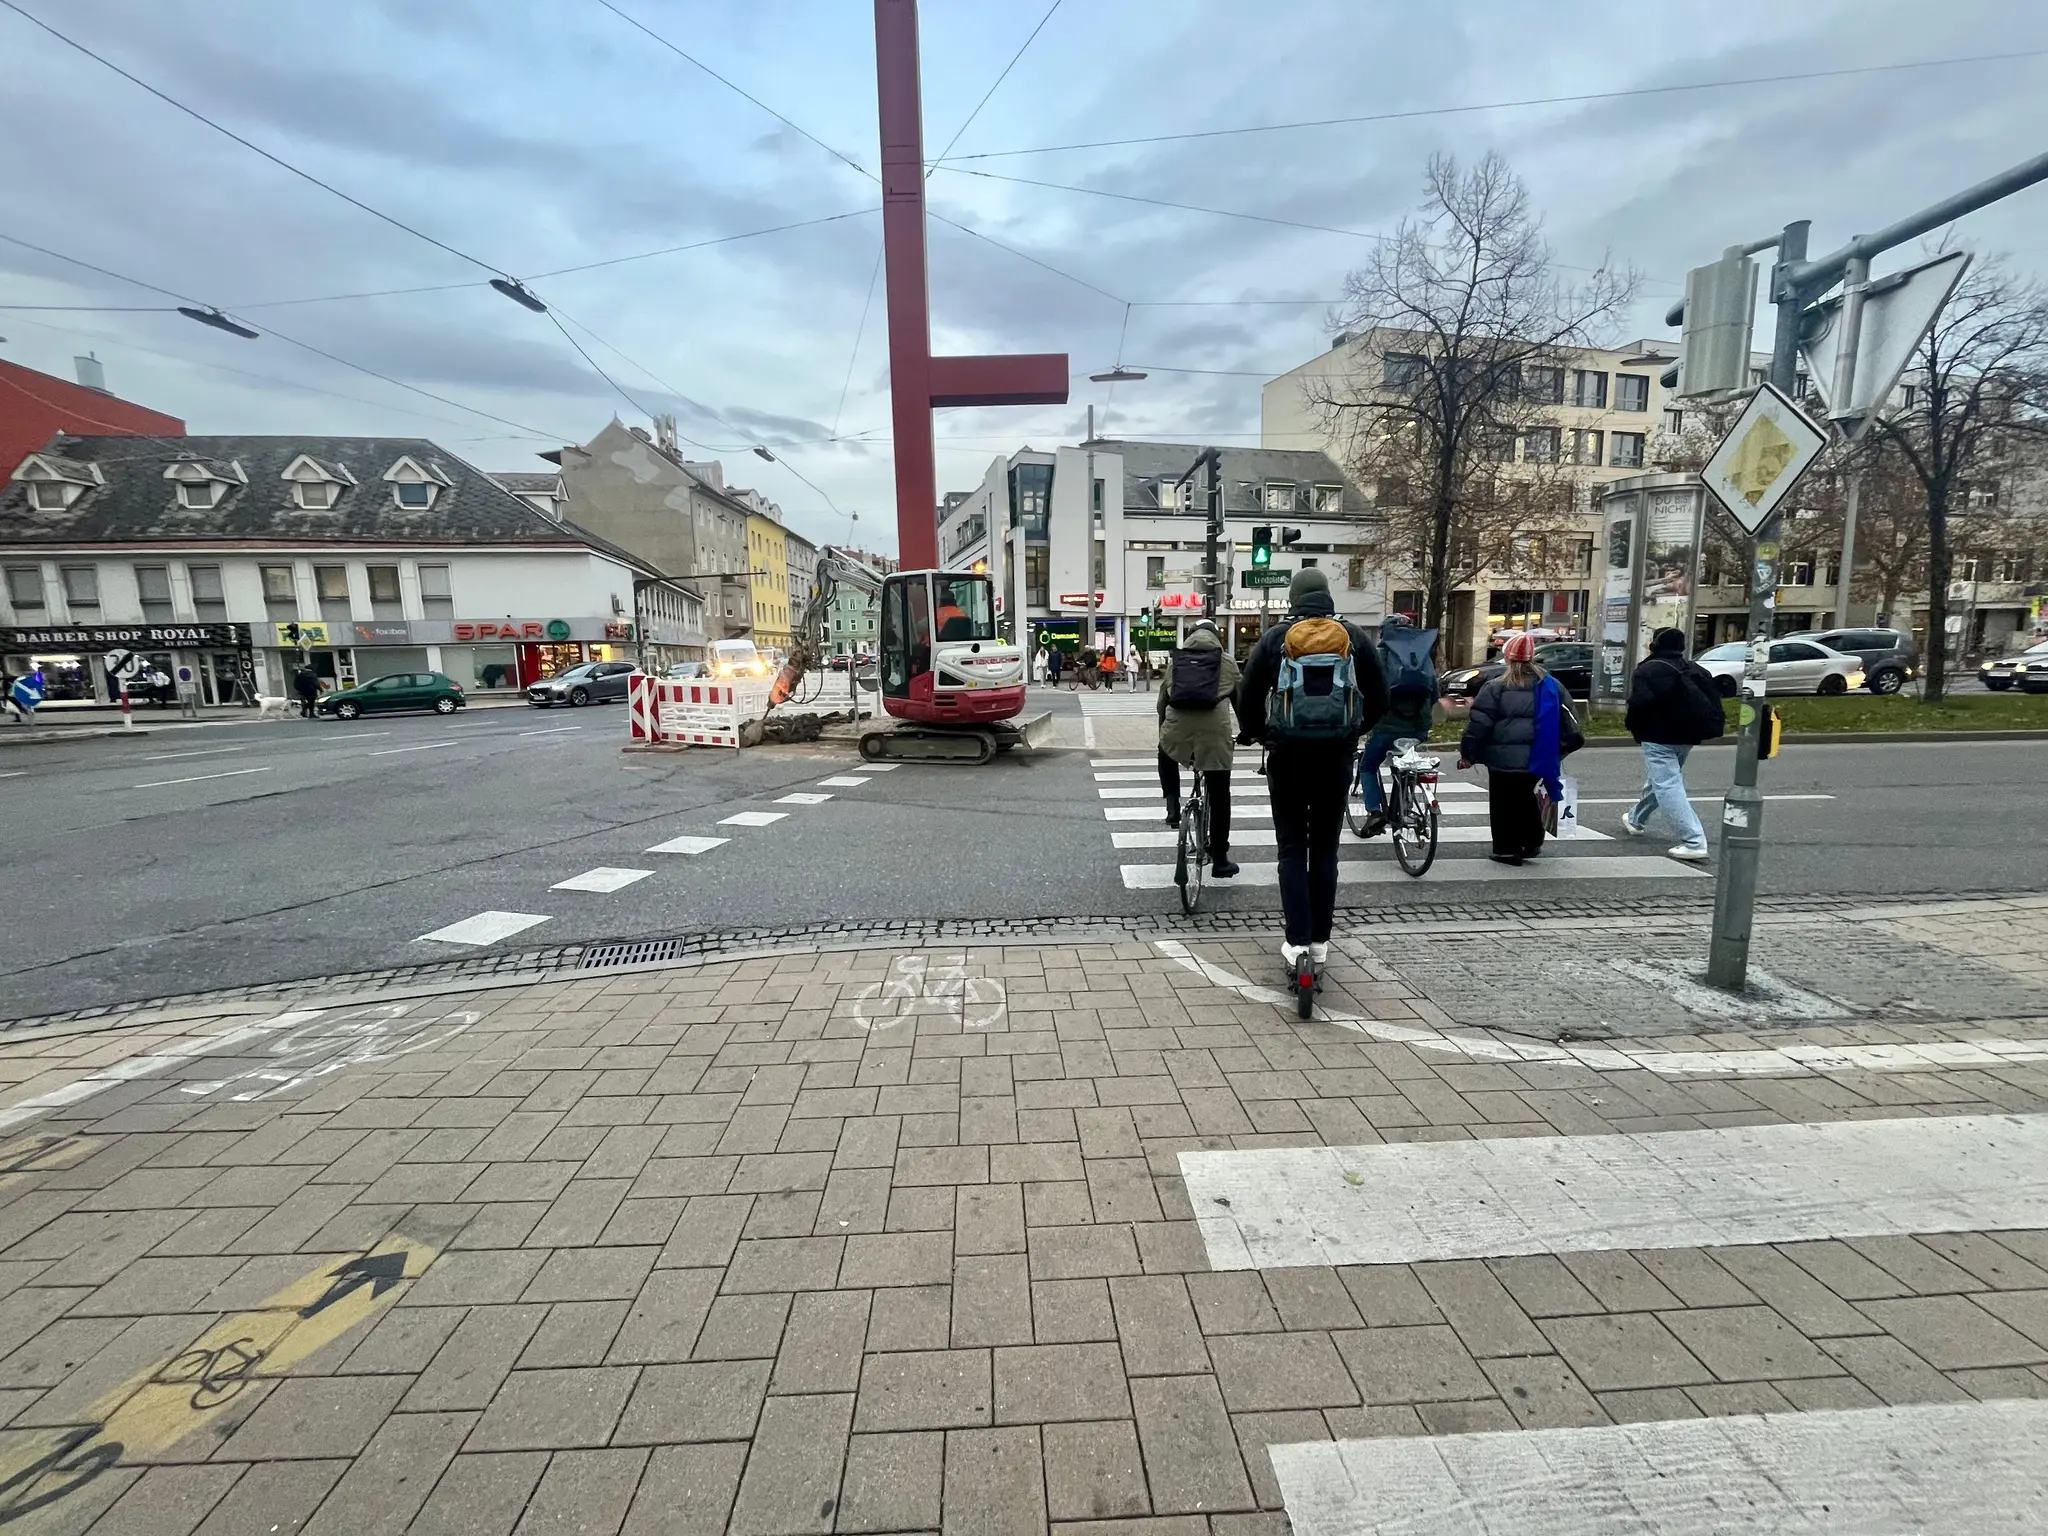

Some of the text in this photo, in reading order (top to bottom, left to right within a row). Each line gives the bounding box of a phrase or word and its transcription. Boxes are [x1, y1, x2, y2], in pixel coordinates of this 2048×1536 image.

[1654, 504, 1686, 515] NICHT
[1230, 599, 1257, 609] LEND
[15, 628, 211, 643] BARBER SHOP ROYAL
[454, 622, 544, 640] SPAR
